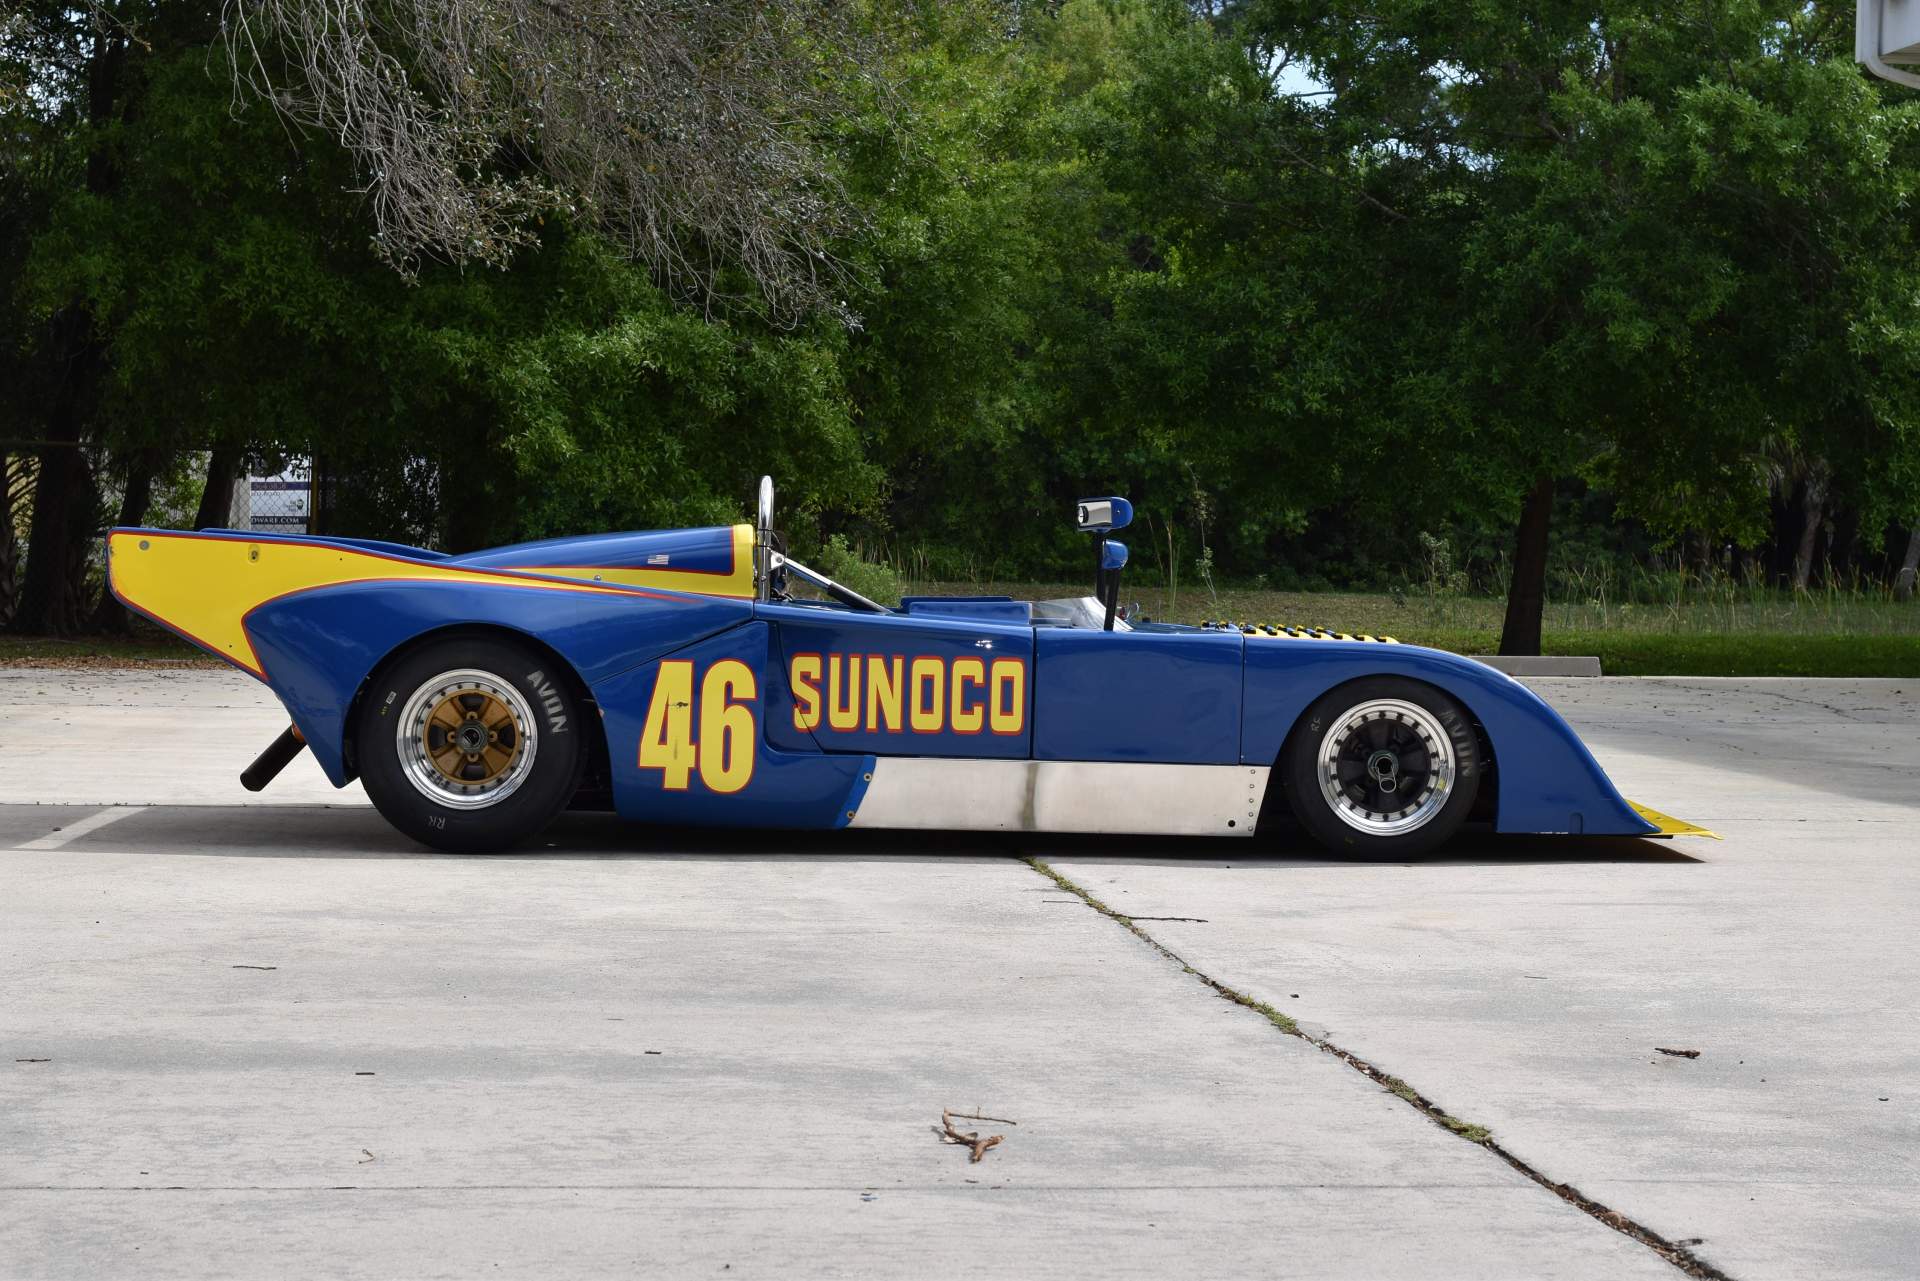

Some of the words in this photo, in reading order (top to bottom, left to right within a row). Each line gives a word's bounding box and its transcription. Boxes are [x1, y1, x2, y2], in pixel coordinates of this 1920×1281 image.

[526, 670, 569, 734] AVON
[637, 658, 757, 794] 46
[790, 651, 1026, 735] SUNOCO
[1439, 710, 1474, 777] AVON
